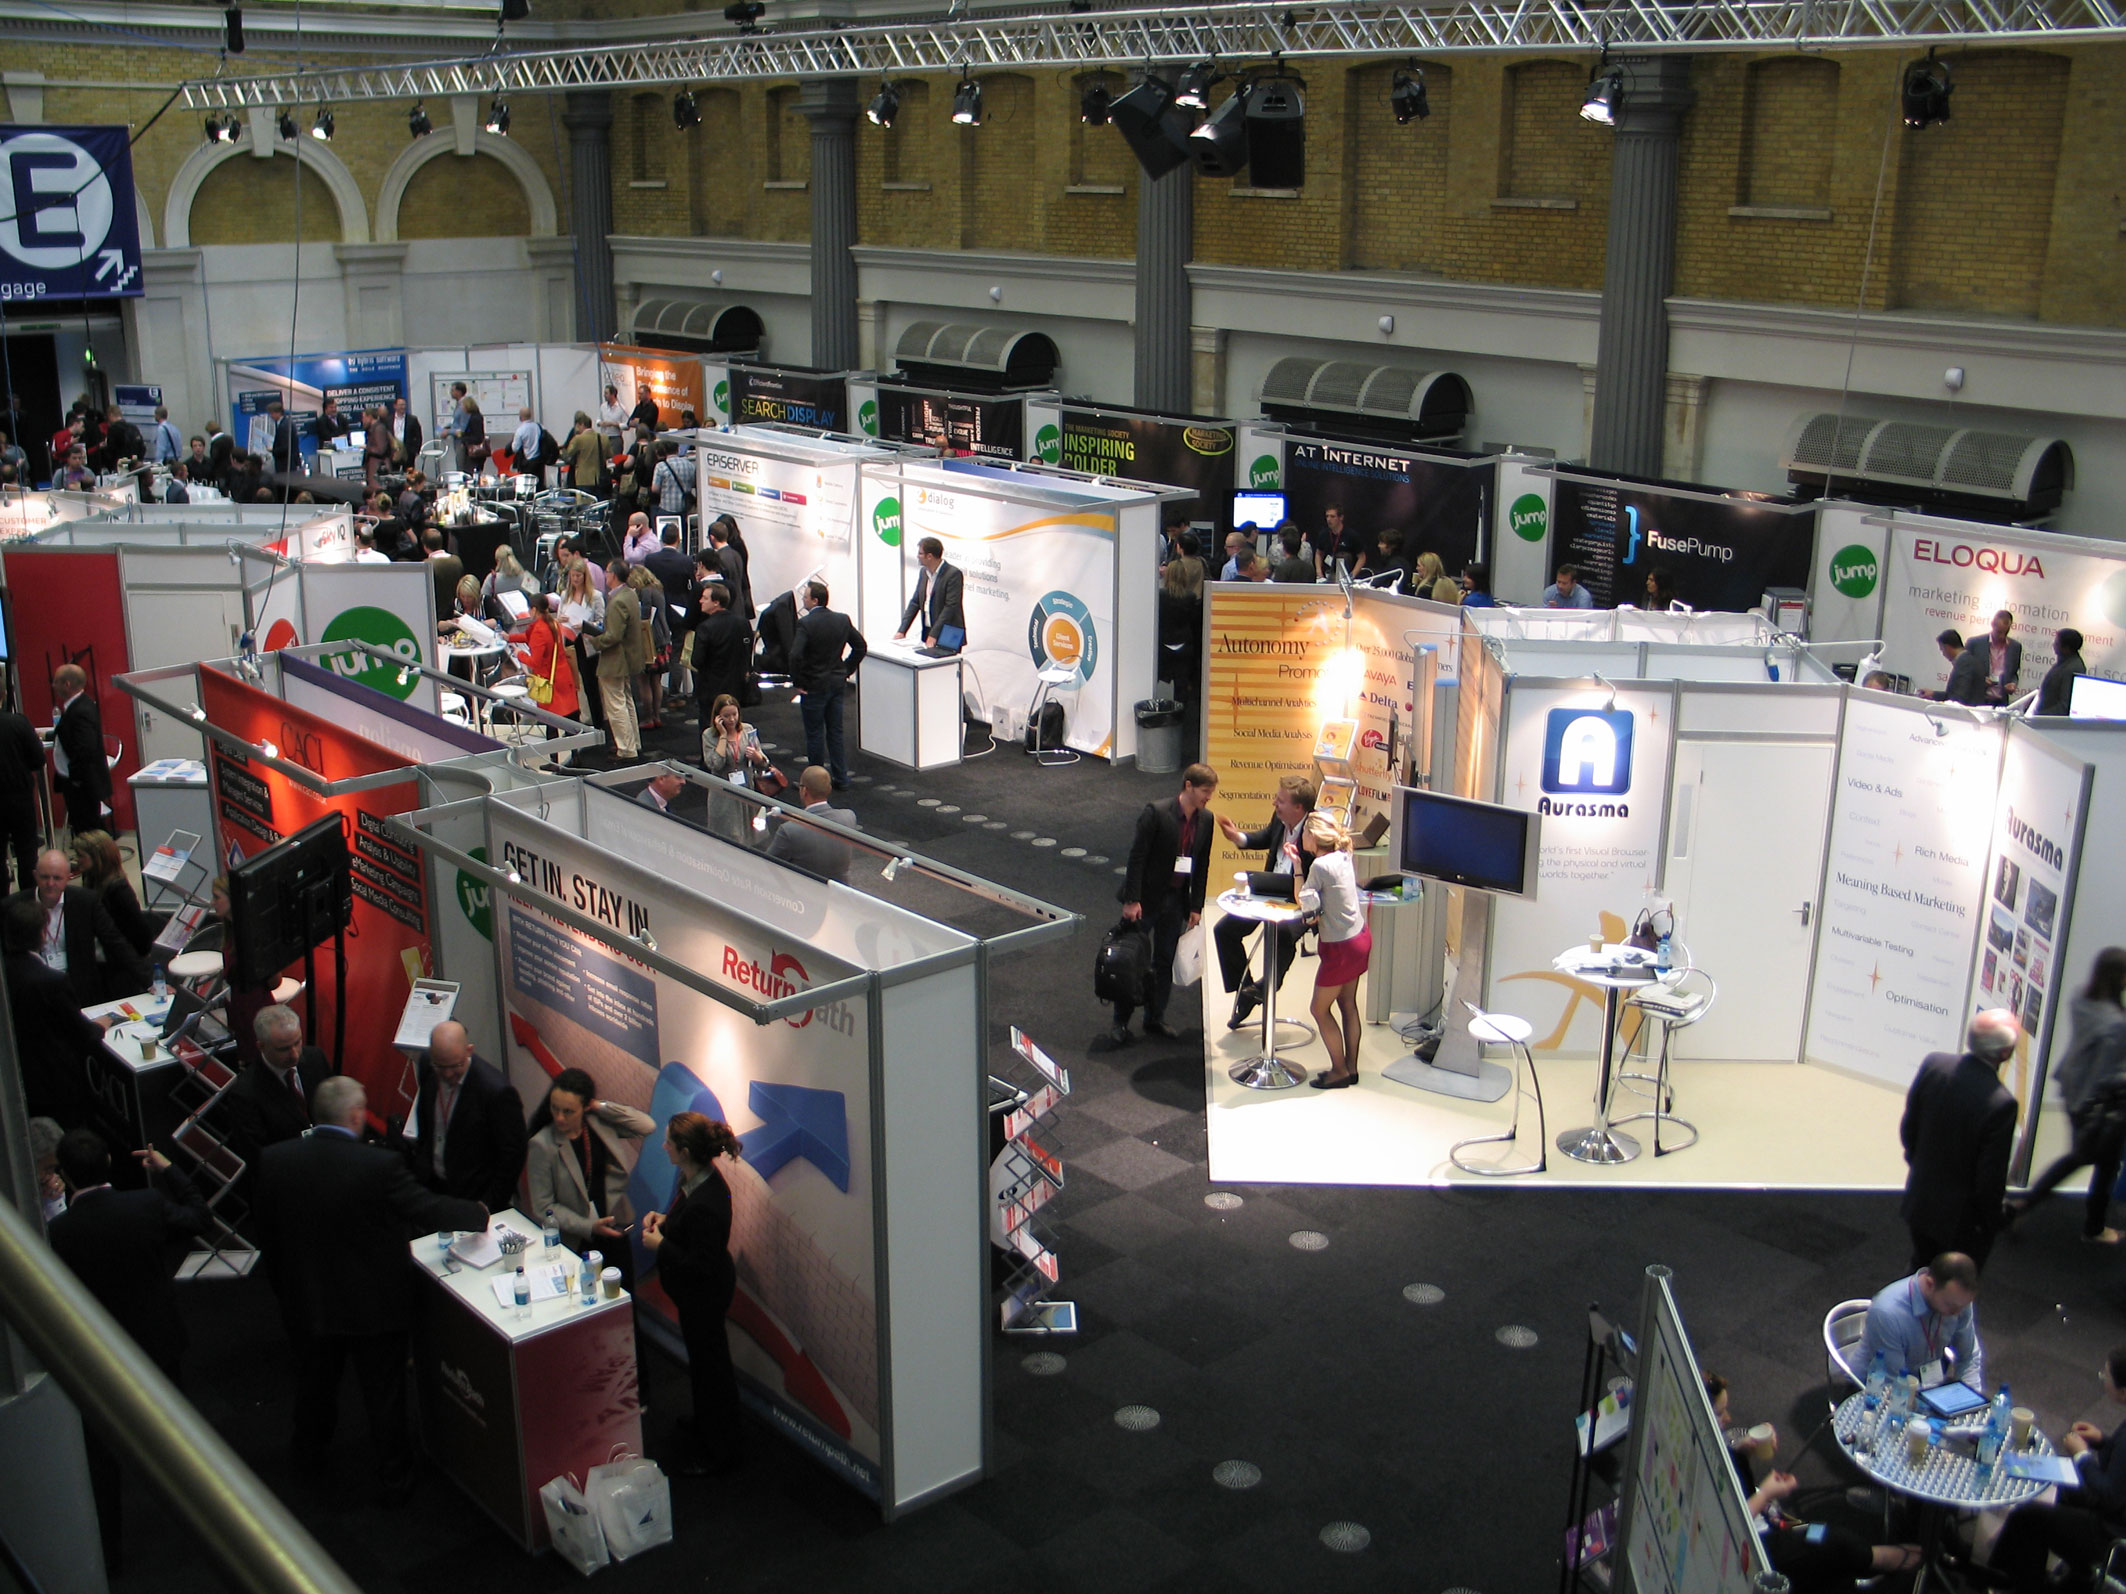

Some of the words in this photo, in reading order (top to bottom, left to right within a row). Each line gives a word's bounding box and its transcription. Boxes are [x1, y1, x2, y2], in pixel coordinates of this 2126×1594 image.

[327, 388, 352, 397] DELIVER
[359, 385, 395, 394] CONSISTENT
[1064, 433, 1135, 461] INSPIRING
[1295, 445, 1316, 458] AT
[927, 493, 955, 509] dialog
[1512, 507, 1547, 530] jump
[1913, 538, 2045, 579] ELOQUA
[1833, 562, 1877, 585] jump
[1908, 585, 1980, 610] marketing
[1924, 606, 1966, 622] revenue
[1218, 633, 1310, 660] Autonomy
[1364, 669, 1397, 686] AVAYA
[1232, 696, 1282, 708] Multichannel
[1370, 692, 1398, 709] Delta
[1233, 728, 1255, 738] Social
[1257, 728, 1281, 738] Media
[1282, 729, 1313, 739] Analysis
[281, 721, 325, 774] CACI
[1230, 759, 1263, 770] Revenue
[1264, 760, 1314, 772] Optimisation
[1218, 790, 1271, 801] Segmentation
[1847, 777, 1873, 792] Video
[1875, 784, 1882, 794] &
[1884, 786, 1903, 798] Ads
[1538, 796, 1629, 818] Aurasma
[383, 848, 389, 860] &
[1222, 851, 1239, 860] Rich
[1241, 851, 1264, 861] Media
[1584, 847, 1609, 856] Visual
[1914, 845, 1936, 859] Rich
[1938, 851, 1969, 867] Media
[1539, 871, 1568, 880] worlds
[1547, 859, 1561, 867] the
[1563, 859, 1598, 871] physical
[1601, 859, 1618, 868] and
[1620, 859, 1646, 869] virtual
[351, 877, 367, 897] Social
[368, 887, 388, 908] Media
[504, 840, 538, 887] GET
[572, 874, 622, 929] STAY
[1836, 871, 1878, 895] Meaning
[1880, 883, 1911, 901] Based
[1914, 891, 1966, 917] Marketing
[1831, 926, 1882, 947] Multivariable
[1884, 937, 1914, 957] Testing
[722, 944, 797, 1001] Return
[1885, 990, 1949, 1016] Optimisation
